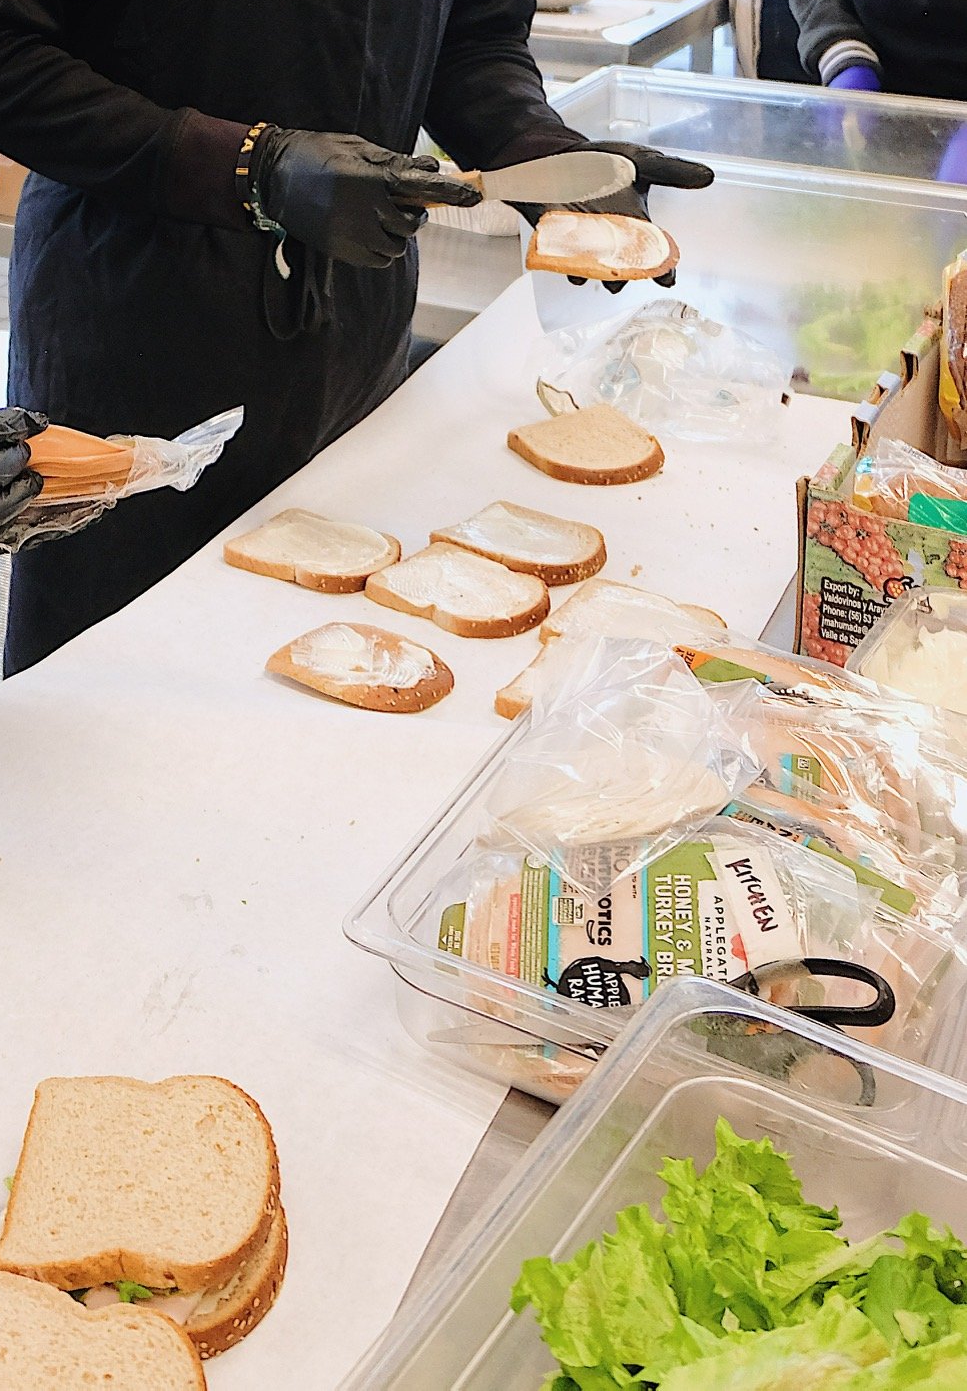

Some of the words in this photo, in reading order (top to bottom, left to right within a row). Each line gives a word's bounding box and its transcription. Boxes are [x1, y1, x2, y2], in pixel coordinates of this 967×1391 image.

[823, 592, 861, 609] Valdovinos
[862, 602, 868, 612] y
[868, 603, 885, 616] Aray
[824, 579, 847, 593] Export
[848, 584, 860, 597] by:
[823, 604, 847, 618] Phone:
[821, 628, 838, 641] Valle
[839, 634, 849, 643] de
[654, 874, 674, 944] TURKEY
[674, 874, 694, 933] HONEY
[725, 858, 779, 932] KITCHEN
[675, 939, 692, 952] &
[704, 916, 714, 978] NATURALS
[655, 950, 675, 985] BRE
[581, 963, 602, 1009] HUMA
[603, 972, 621, 1008] APPLE
